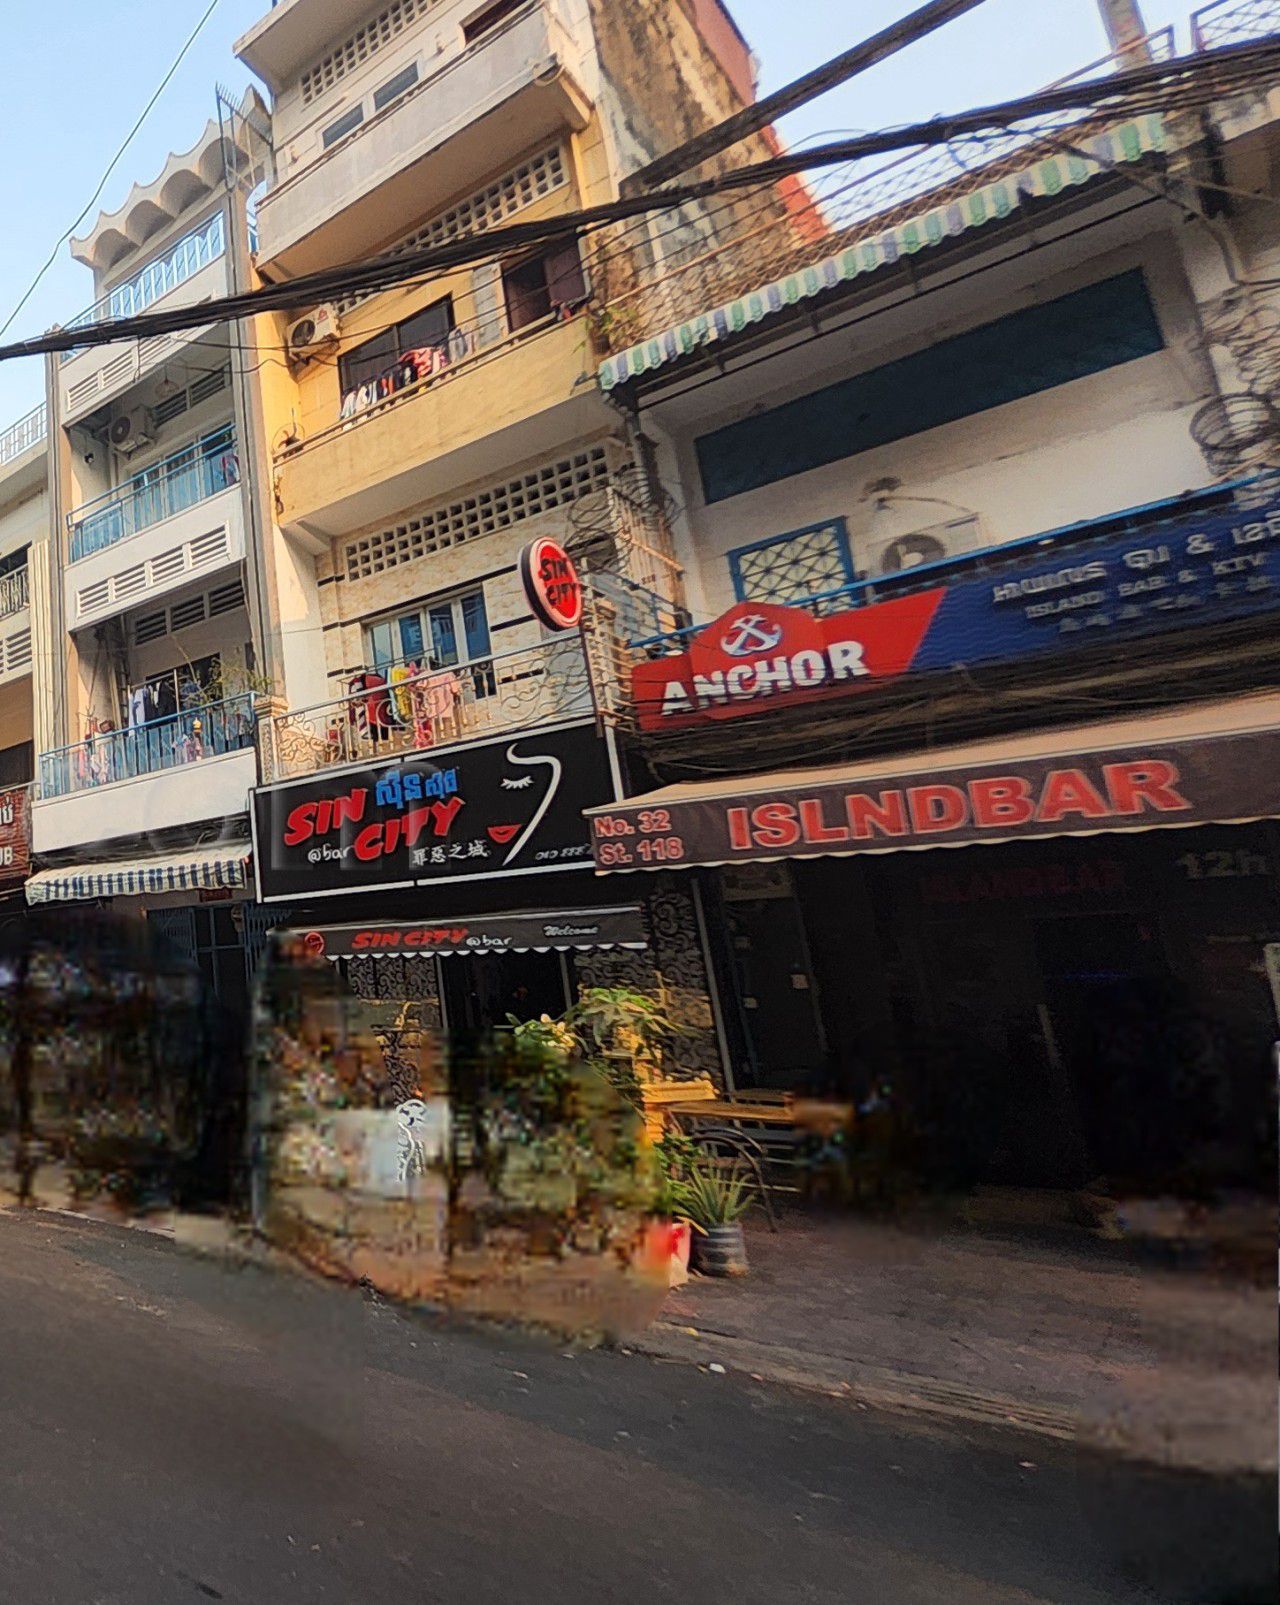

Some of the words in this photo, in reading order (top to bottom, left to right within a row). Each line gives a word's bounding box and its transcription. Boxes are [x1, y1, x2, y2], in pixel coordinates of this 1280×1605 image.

[539, 557, 570, 580] SIN
[546, 583, 579, 606] CITY
[661, 640, 869, 716] ANCHOR
[284, 788, 367, 846] SIN
[727, 758, 1192, 850] ISLNDBAR
[354, 796, 466, 861] CITY
[594, 815, 635, 838] No.
[637, 809, 672, 833] 32
[307, 843, 355, 864] @bar
[599, 843, 634, 866] St.
[637, 837, 685, 862] 118
[352, 930, 400, 949] SIN
[403, 927, 469, 946] CITY
[466, 934, 513, 948] @bar
[543, 924, 599, 936] Welcome
